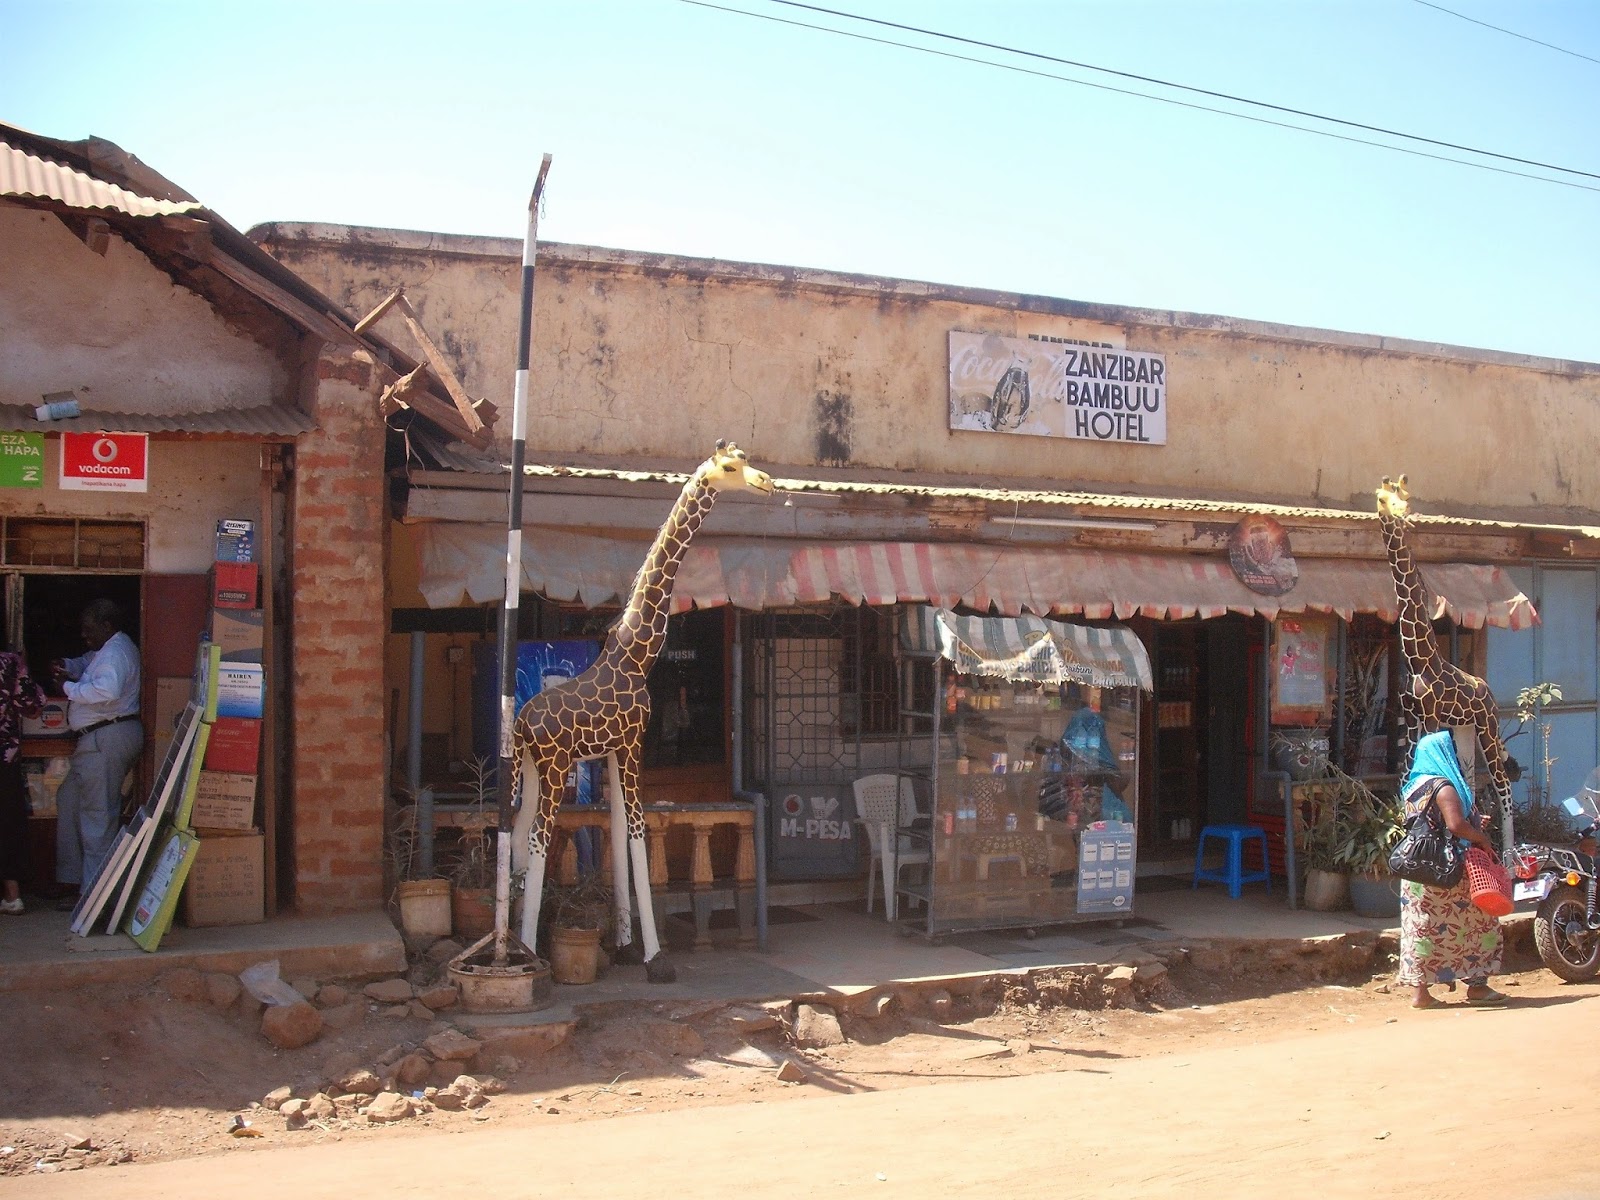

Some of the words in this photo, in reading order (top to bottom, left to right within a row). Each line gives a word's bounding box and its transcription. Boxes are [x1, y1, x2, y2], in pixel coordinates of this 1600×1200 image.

[1065, 350, 1164, 385] ZANZIBAR
[1066, 380, 1160, 412] BAMBUU
[1075, 409, 1150, 442] HOTEL
[4, 446, 40, 456] HAPA
[79, 464, 131, 474] vodacom
[668, 651, 695, 660] PUSH
[781, 818, 851, 840] M-PESA
